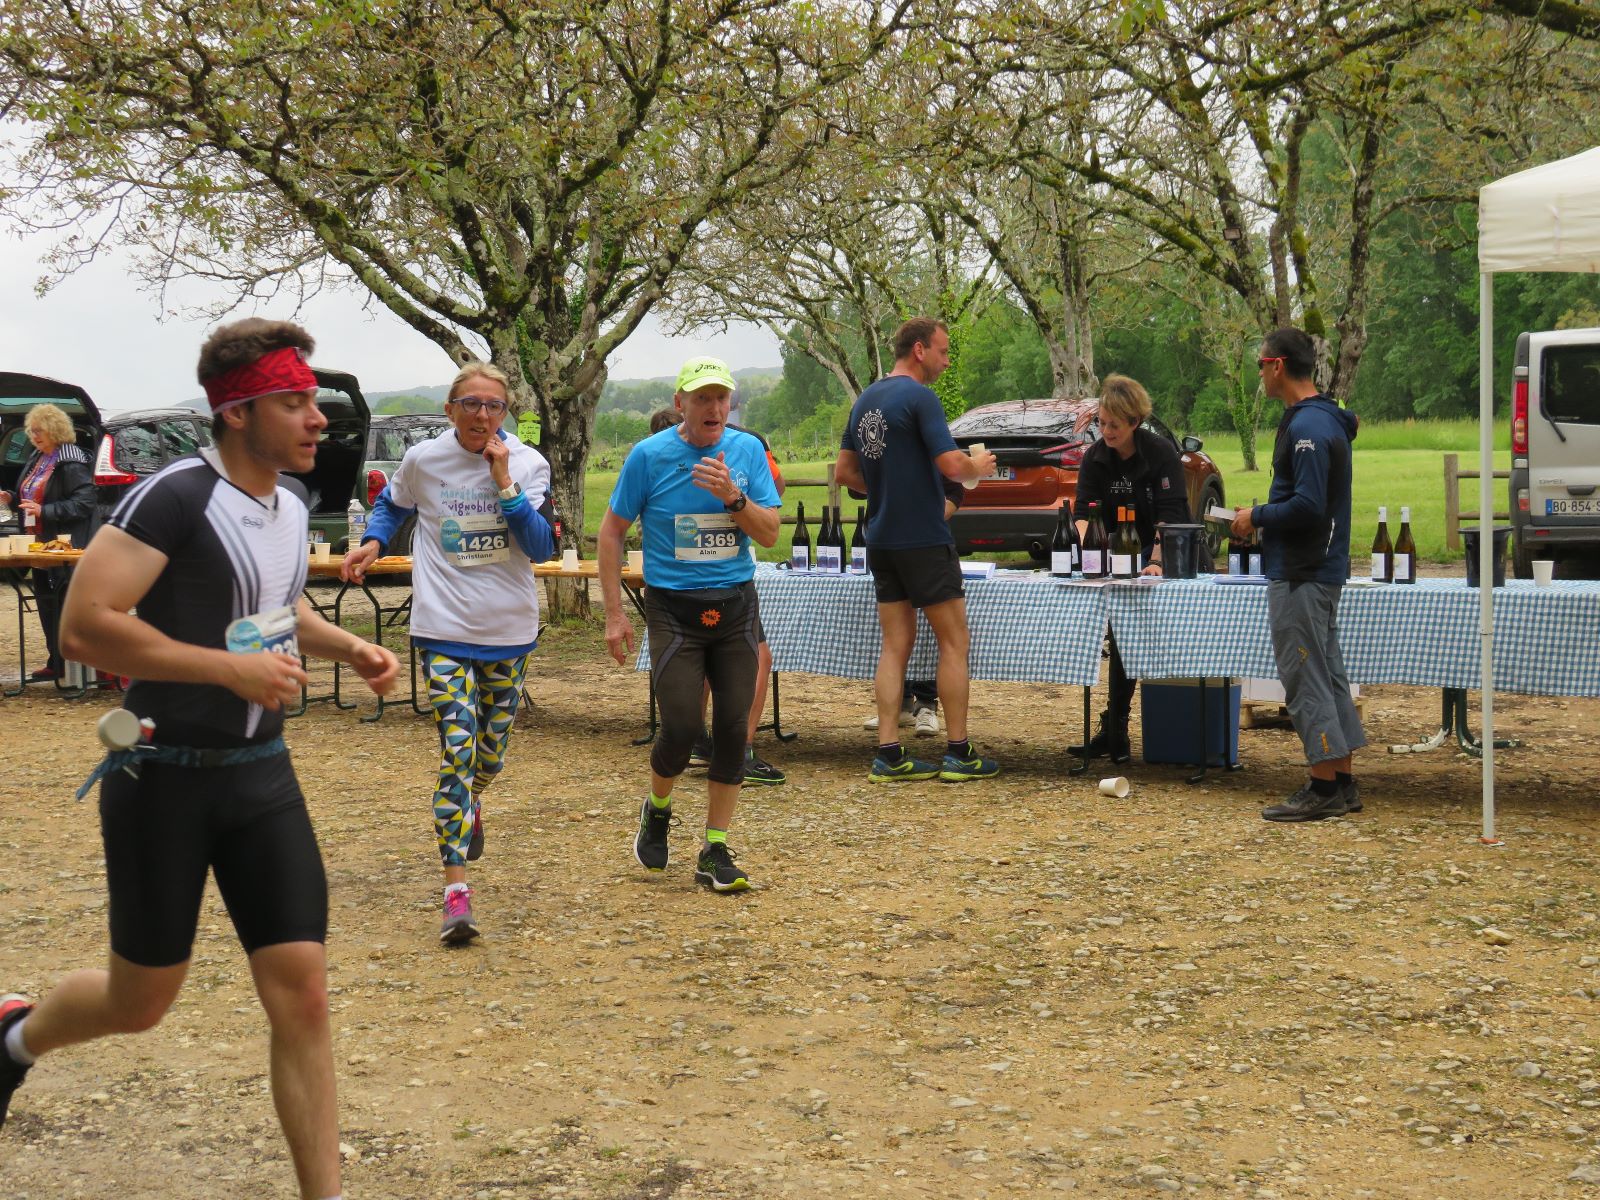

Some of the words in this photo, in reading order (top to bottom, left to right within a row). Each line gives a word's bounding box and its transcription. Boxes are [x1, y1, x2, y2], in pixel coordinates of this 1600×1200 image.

[703, 364, 722, 372] asics
[448, 500, 498, 516] vignobles
[457, 534, 505, 551] 1426
[693, 532, 737, 548] 1369
[456, 552, 493, 561] Christiane
